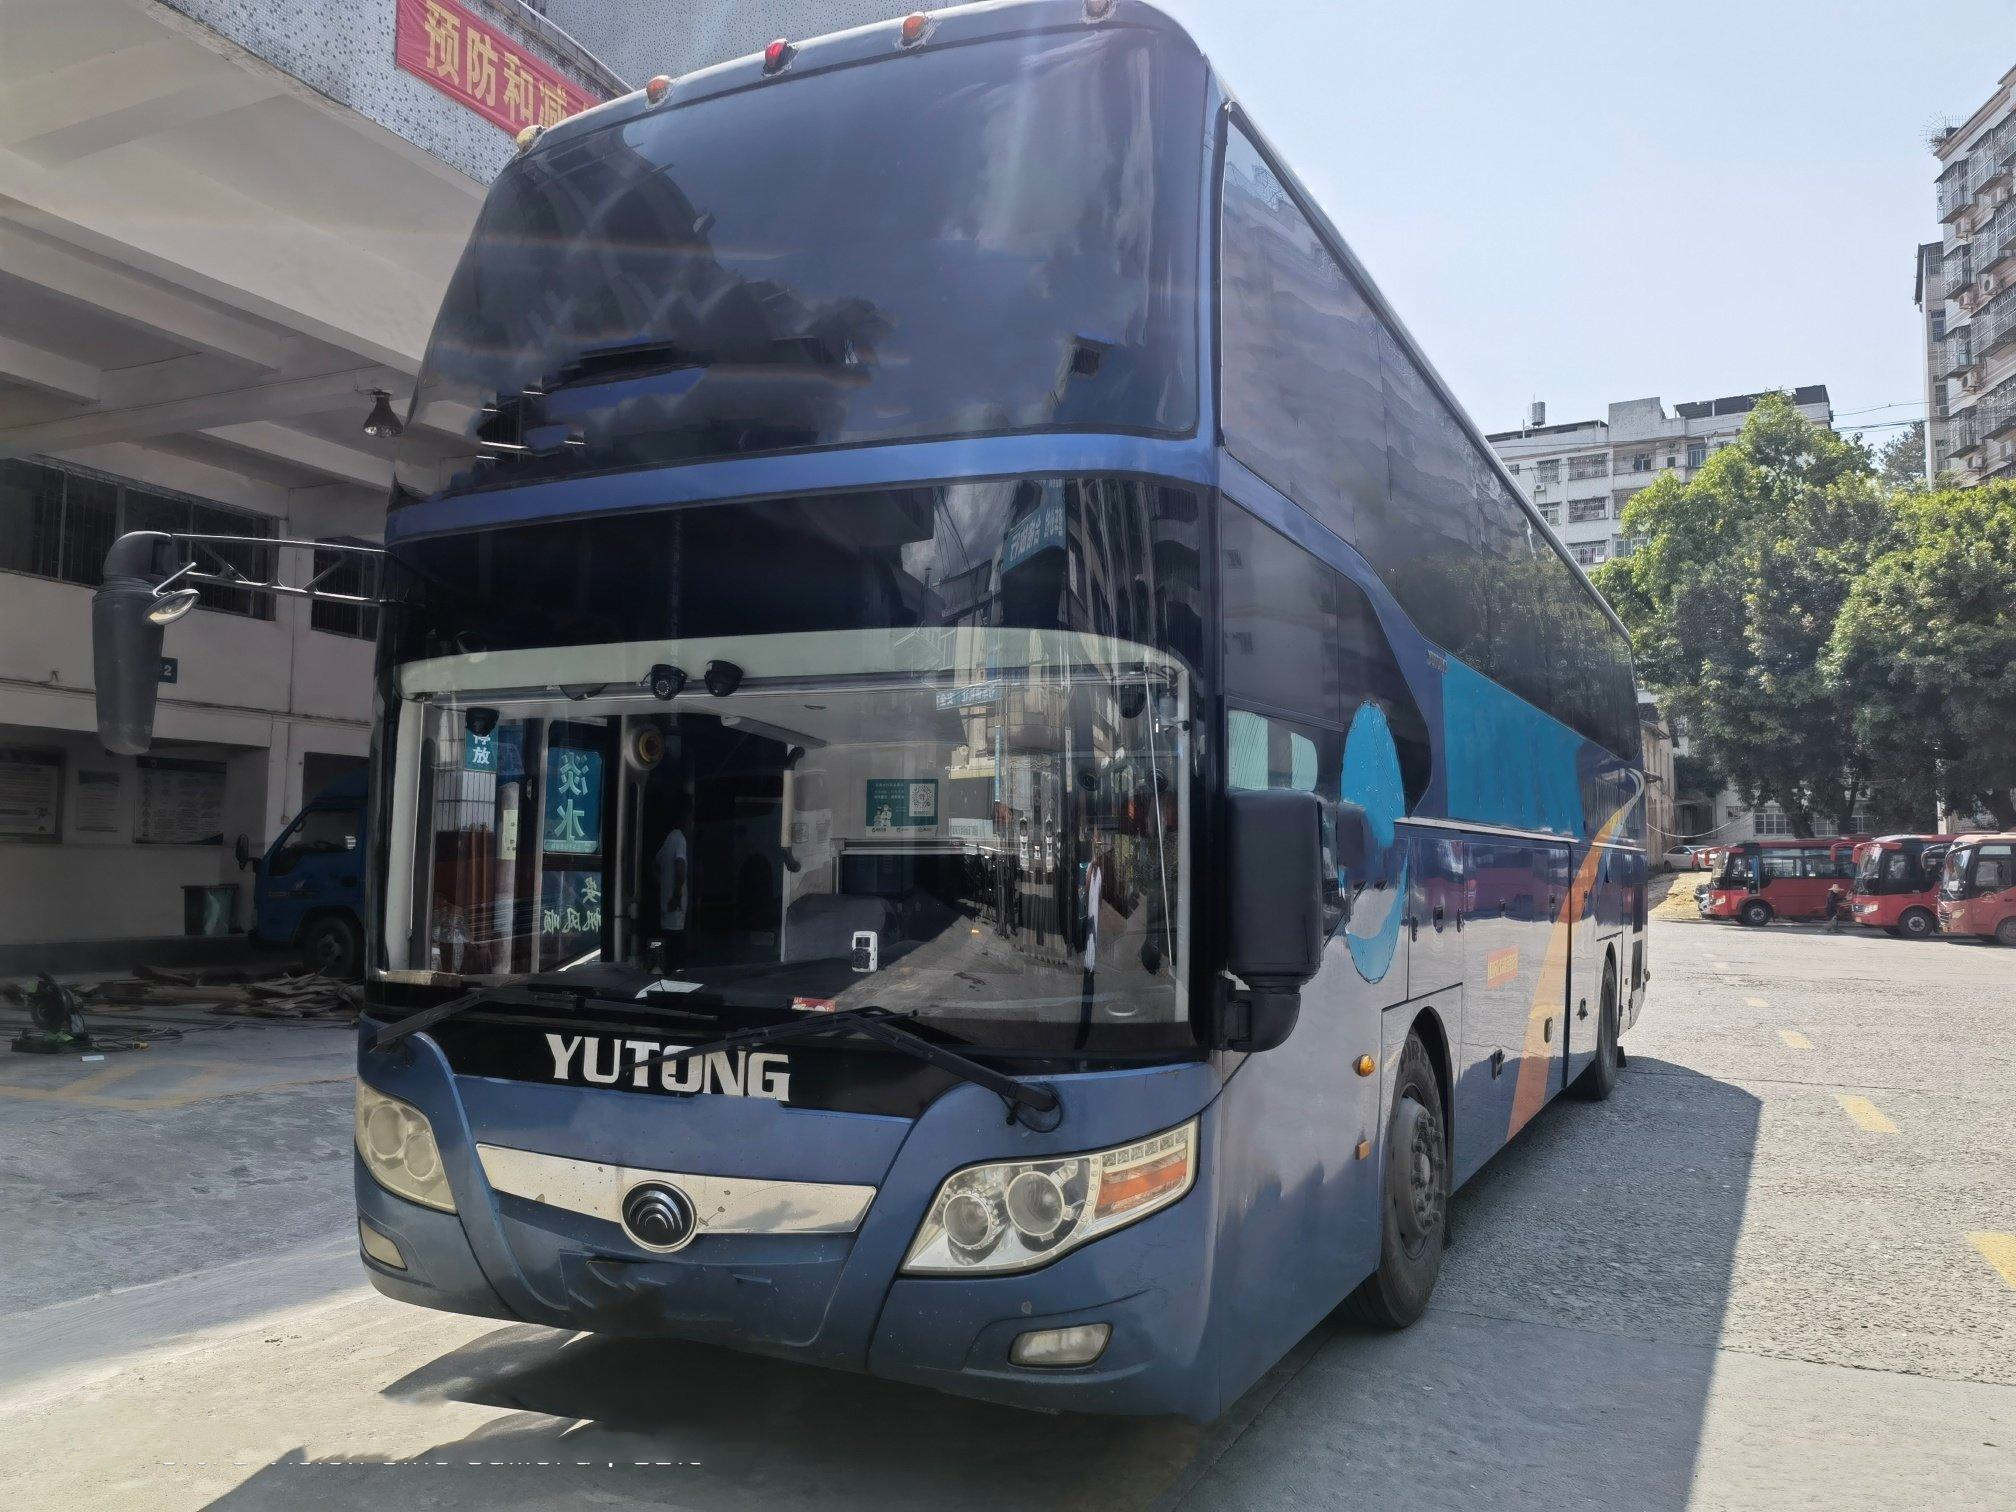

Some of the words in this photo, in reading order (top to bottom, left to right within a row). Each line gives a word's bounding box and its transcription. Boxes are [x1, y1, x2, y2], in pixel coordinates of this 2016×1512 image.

[424, 0, 592, 126] 预防和减
[545, 1033, 790, 1102] YUTONG
